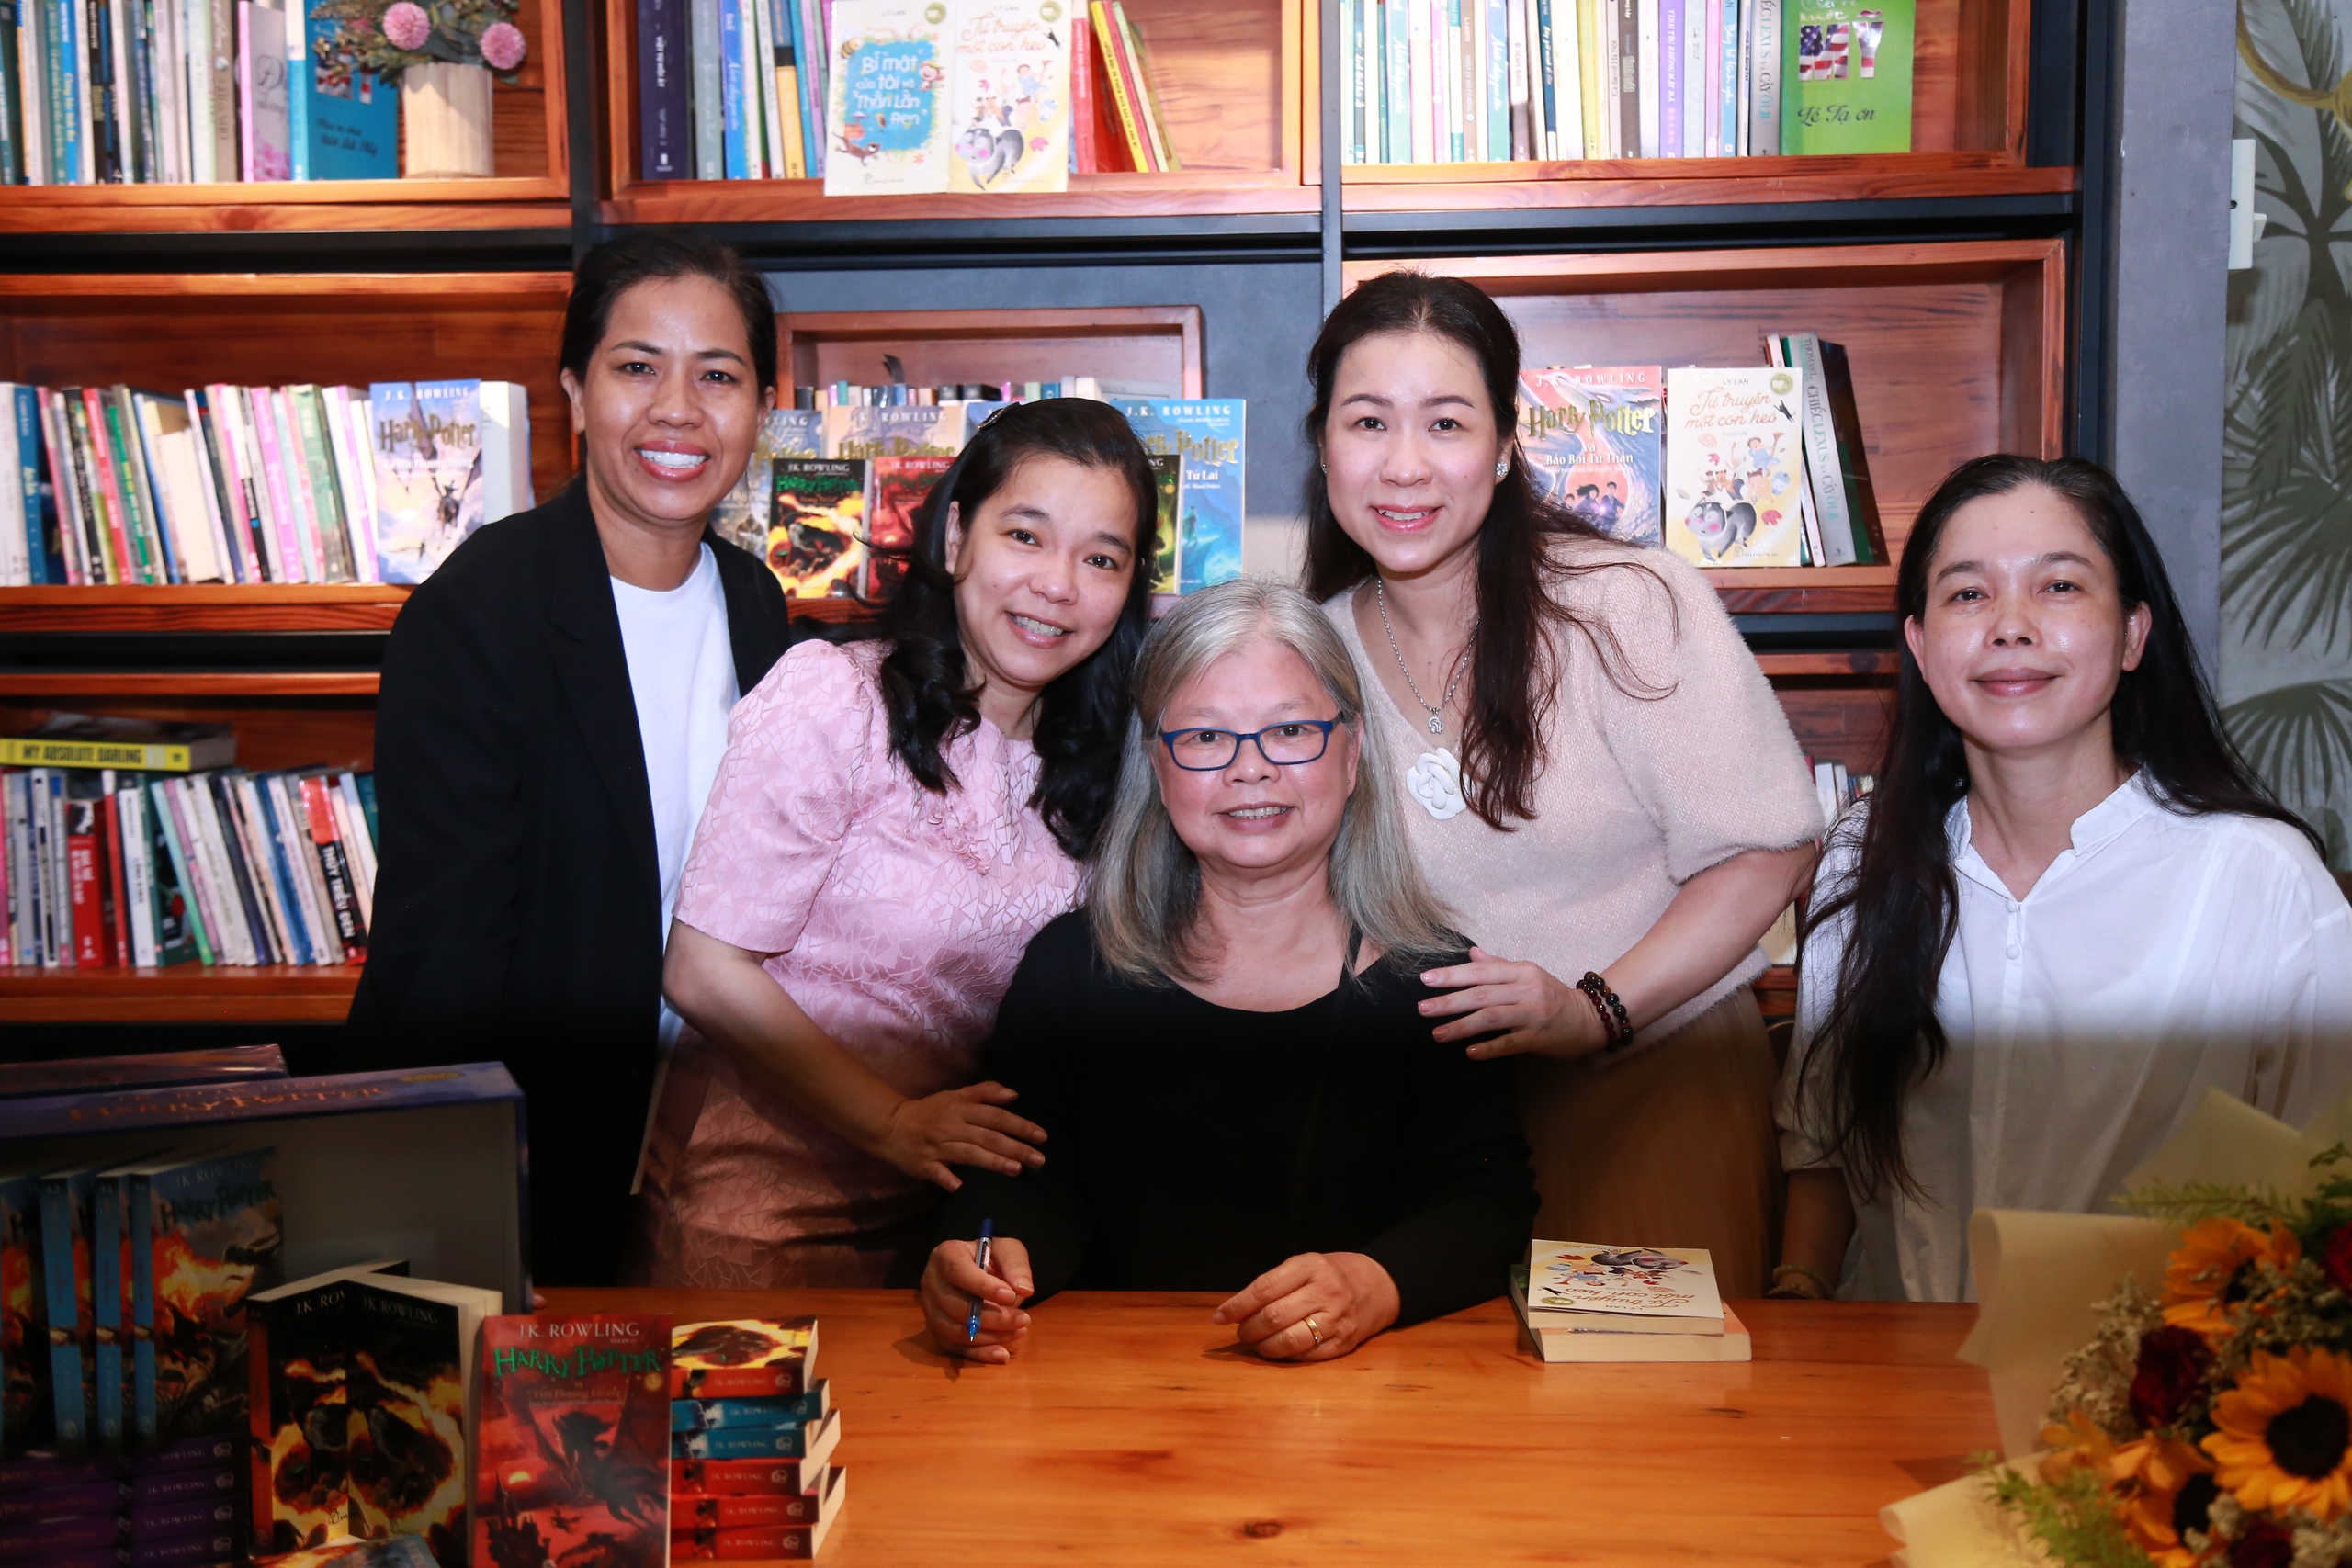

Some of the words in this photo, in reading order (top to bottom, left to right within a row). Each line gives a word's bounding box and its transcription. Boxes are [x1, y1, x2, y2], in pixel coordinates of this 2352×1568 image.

[1759, 17, 1773, 58] LEXUS
[1575, 373, 1646, 386] ROWLING
[416, 387, 470, 400] ROWLING
[1722, 392, 1771, 413] truyện
[1162, 405, 1231, 415] ROWLING
[881, 412, 948, 423] ROWLING
[1528, 405, 1586, 440] Harry
[1589, 399, 1656, 437] Potter
[1685, 412, 1716, 429] một
[1717, 415, 1747, 426] con
[1749, 410, 1778, 423] heo
[379, 418, 429, 452] Harry
[428, 413, 477, 451] Potter
[1175, 430, 1240, 466] Potter
[803, 462, 851, 472] ROWLING
[904, 459, 951, 469] ROWLING
[1202, 469, 1219, 481] Lai
[23, 745, 41, 760] MY
[43, 744, 96, 763] ABSOLUTE
[98, 747, 143, 765] DARLING
[197, 1157, 259, 1184] ROWLING
[1564, 1287, 1601, 1297] heo
[380, 1299, 439, 1325] ROWLING
[517, 1323, 545, 1340] J.K.
[549, 1321, 640, 1338] ROWLING
[493, 1345, 575, 1378] HARRY
[574, 1345, 663, 1377] POTTER
[726, 1377, 768, 1385] ROWLING
[728, 1440, 769, 1449] ROWLING
[161, 1449, 207, 1462] ROWLING
[724, 1472, 764, 1481] ROWLING
[162, 1480, 208, 1493] ROWLING
[739, 1506, 781, 1515] ROWLING
[161, 1513, 208, 1526] ROWLING
[735, 1539, 776, 1547] ROWLING
[160, 1544, 207, 1557] ROWLING
